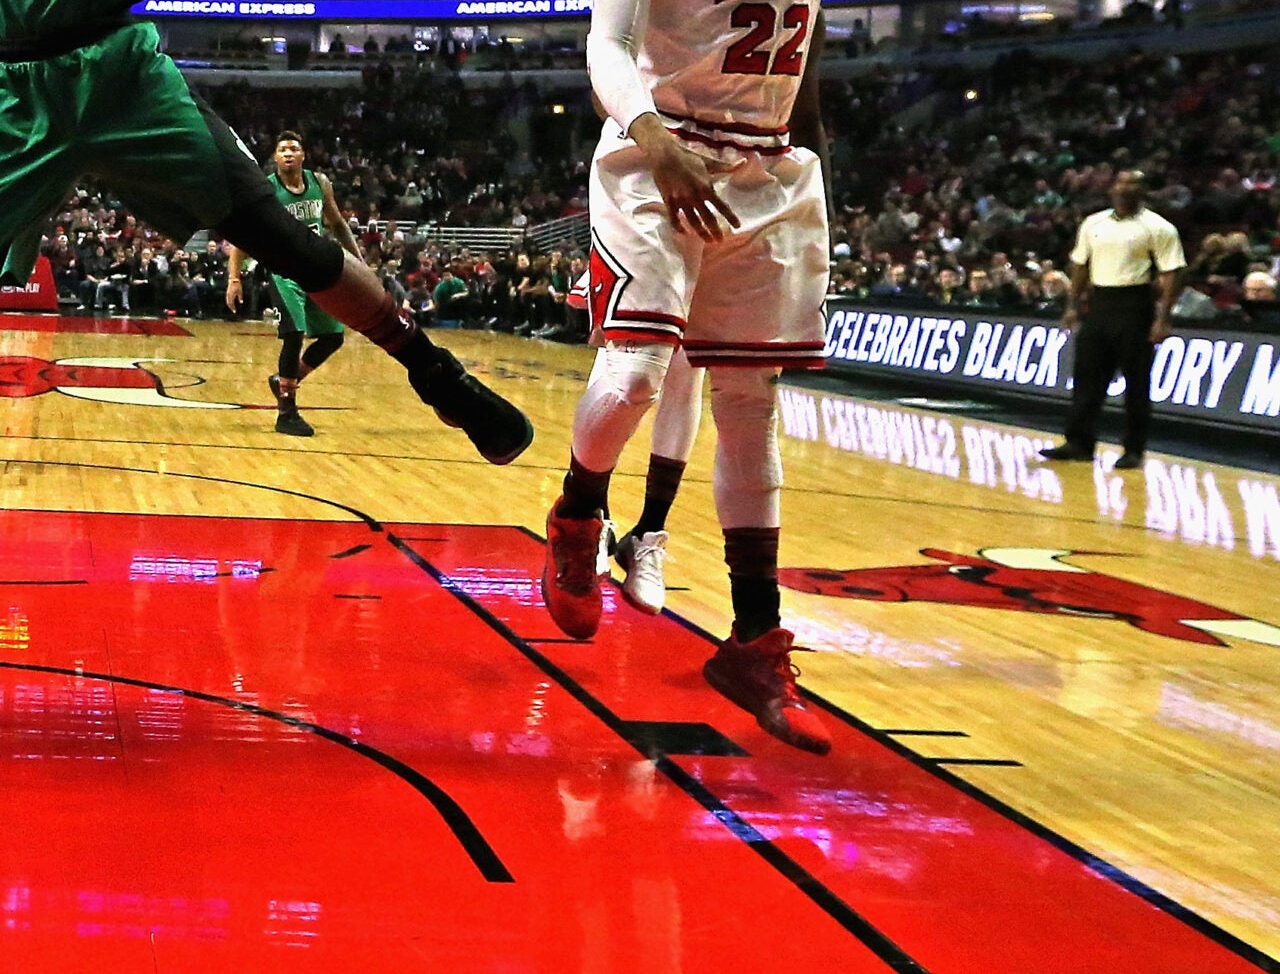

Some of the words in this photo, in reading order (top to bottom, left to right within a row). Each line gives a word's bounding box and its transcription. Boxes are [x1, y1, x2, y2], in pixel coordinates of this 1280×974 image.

[145, 0, 235, 14] AMERICAN
[239, 2, 315, 15] EXPRESS
[456, 0, 551, 14] AMERICAN
[721, 2, 810, 76] 22
[823, 310, 966, 374] CELEBRATES
[963, 322, 1070, 389] BLACK
